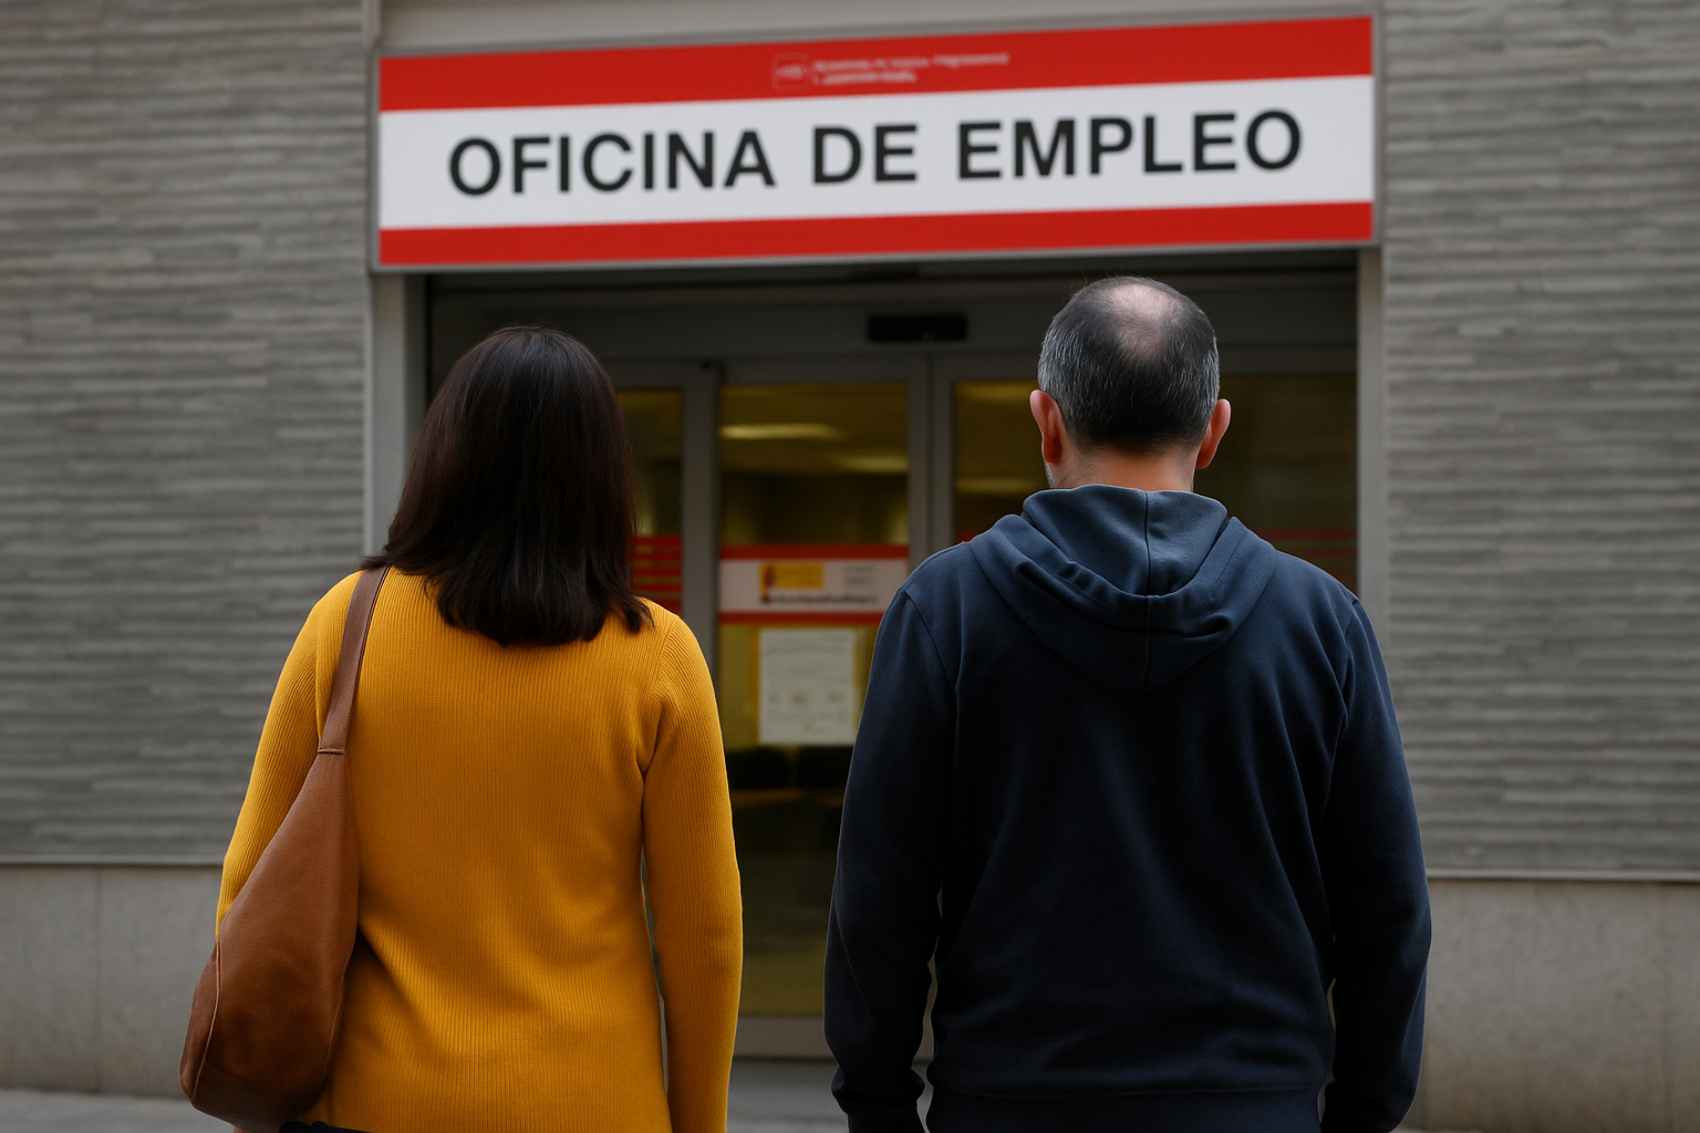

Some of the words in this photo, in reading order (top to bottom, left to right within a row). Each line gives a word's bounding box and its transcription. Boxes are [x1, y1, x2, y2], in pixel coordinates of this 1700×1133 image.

[449, 128, 776, 197] OFICINA
[812, 123, 918, 184] DE
[957, 109, 1302, 181] EMPLEO
